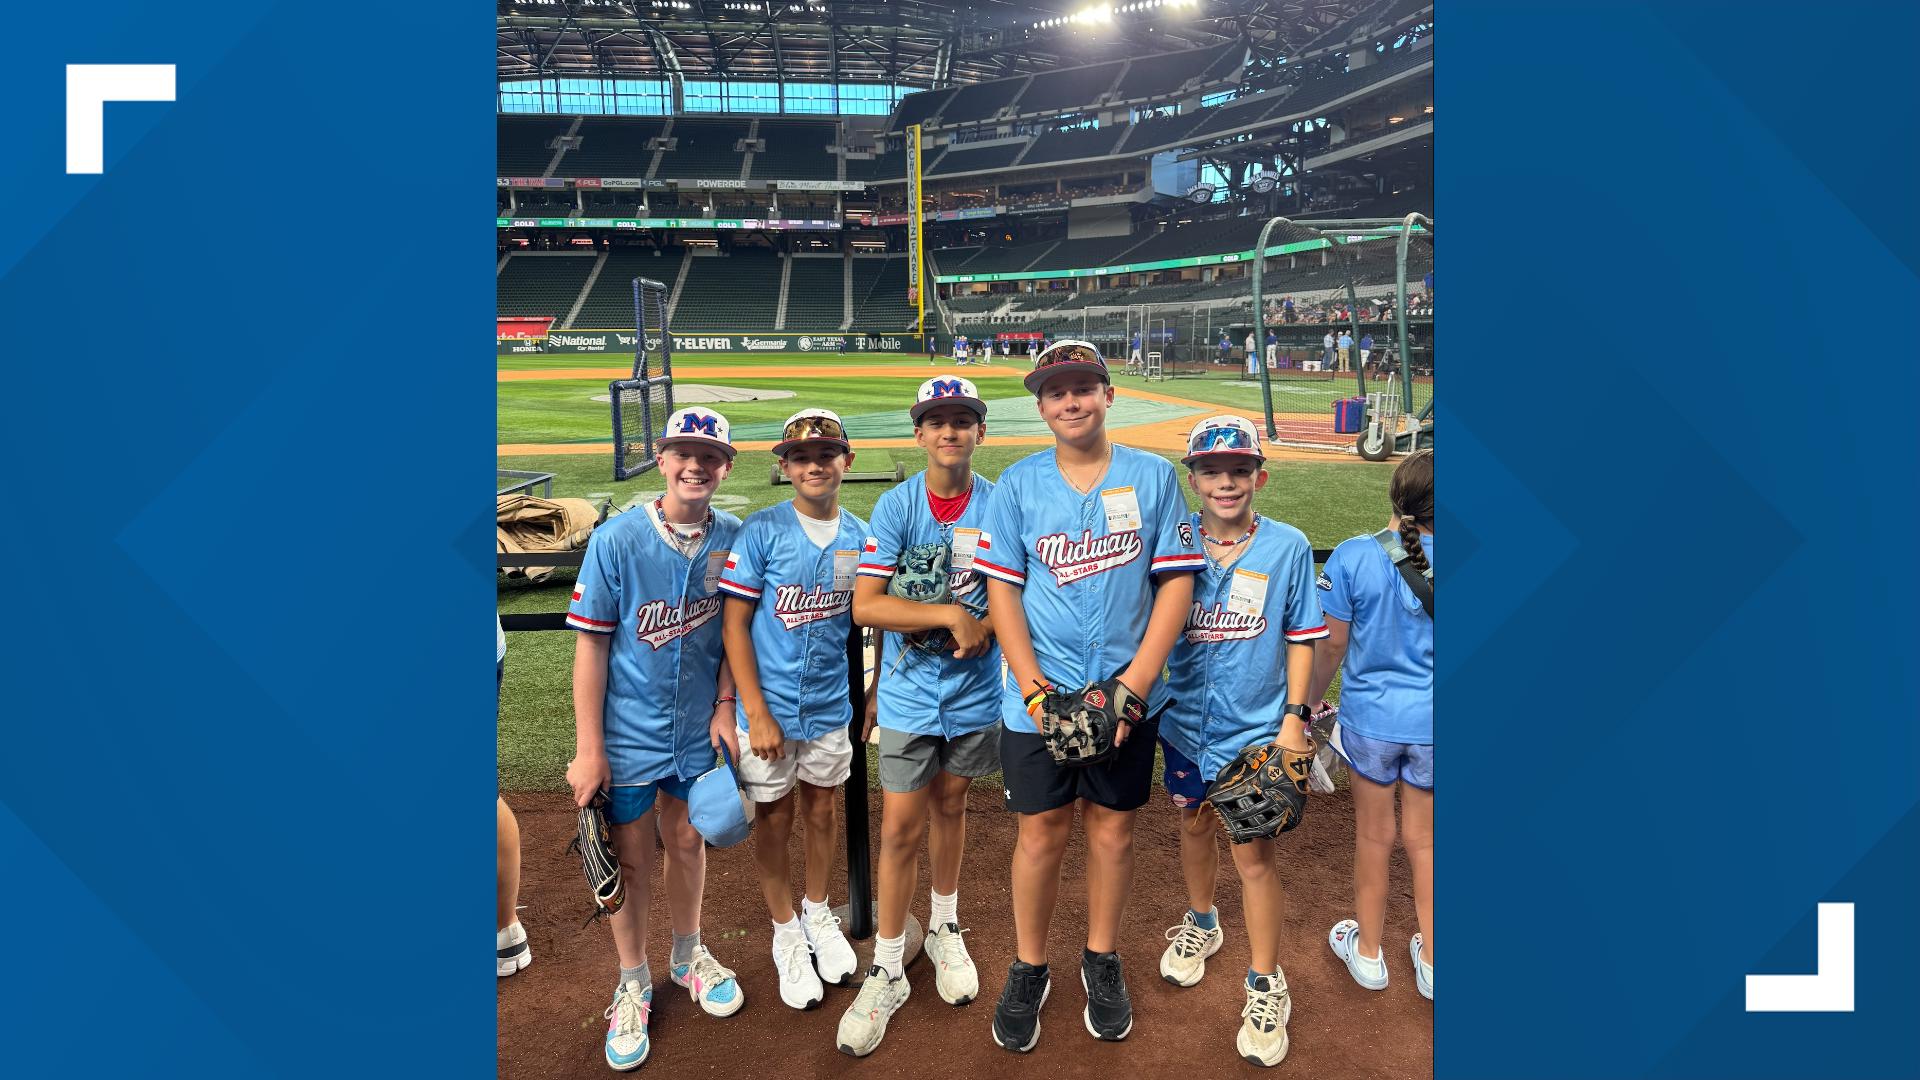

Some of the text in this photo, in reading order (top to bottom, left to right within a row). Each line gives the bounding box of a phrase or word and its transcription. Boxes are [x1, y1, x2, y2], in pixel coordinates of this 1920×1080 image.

[696, 180, 747, 188] POWERADE
[561, 336, 604, 346] National
[673, 337, 731, 350] 7-ELEVEN
[932, 378, 963, 399] M
[680, 413, 718, 438] M
[1037, 529, 1142, 569] Midway
[1059, 563, 1099, 578] AL-STARS
[775, 584, 852, 613] Midway
[637, 596, 721, 634] Midway
[786, 612, 824, 623] ALL-STARS
[1185, 601, 1267, 633] Midway
[1187, 631, 1225, 640] ALL-STARS
